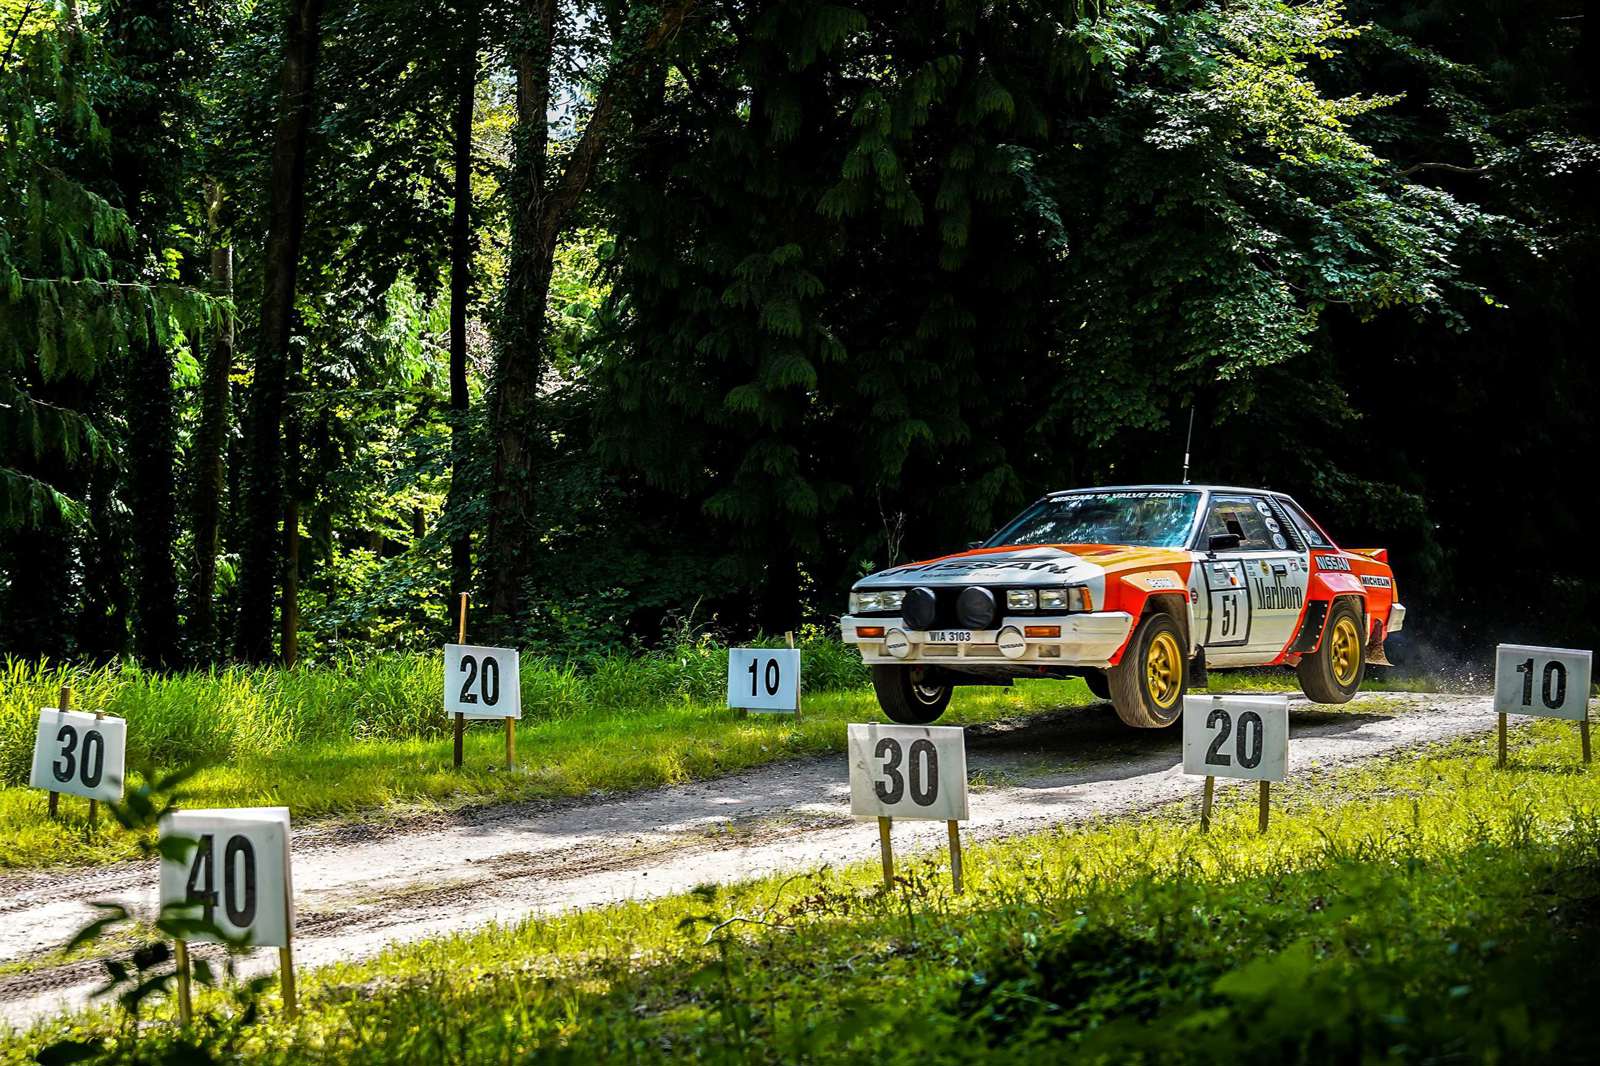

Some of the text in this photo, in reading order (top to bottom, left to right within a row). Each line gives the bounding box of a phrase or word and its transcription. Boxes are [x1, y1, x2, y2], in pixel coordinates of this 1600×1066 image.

[878, 561, 1077, 577] NISSAN
[1315, 556, 1352, 571] NISSAN
[1361, 575, 1390, 587] MICHELIN
[1254, 572, 1303, 610] Marlboro
[1221, 594, 1237, 636] 51
[929, 631, 971, 642] WIA 3103
[459, 654, 500, 706] 20
[748, 658, 780, 697] 10
[1516, 658, 1567, 710] 10
[52, 724, 105, 788] 30
[1205, 708, 1264, 769] 20
[874, 737, 939, 807] 30
[186, 833, 257, 928] 40
